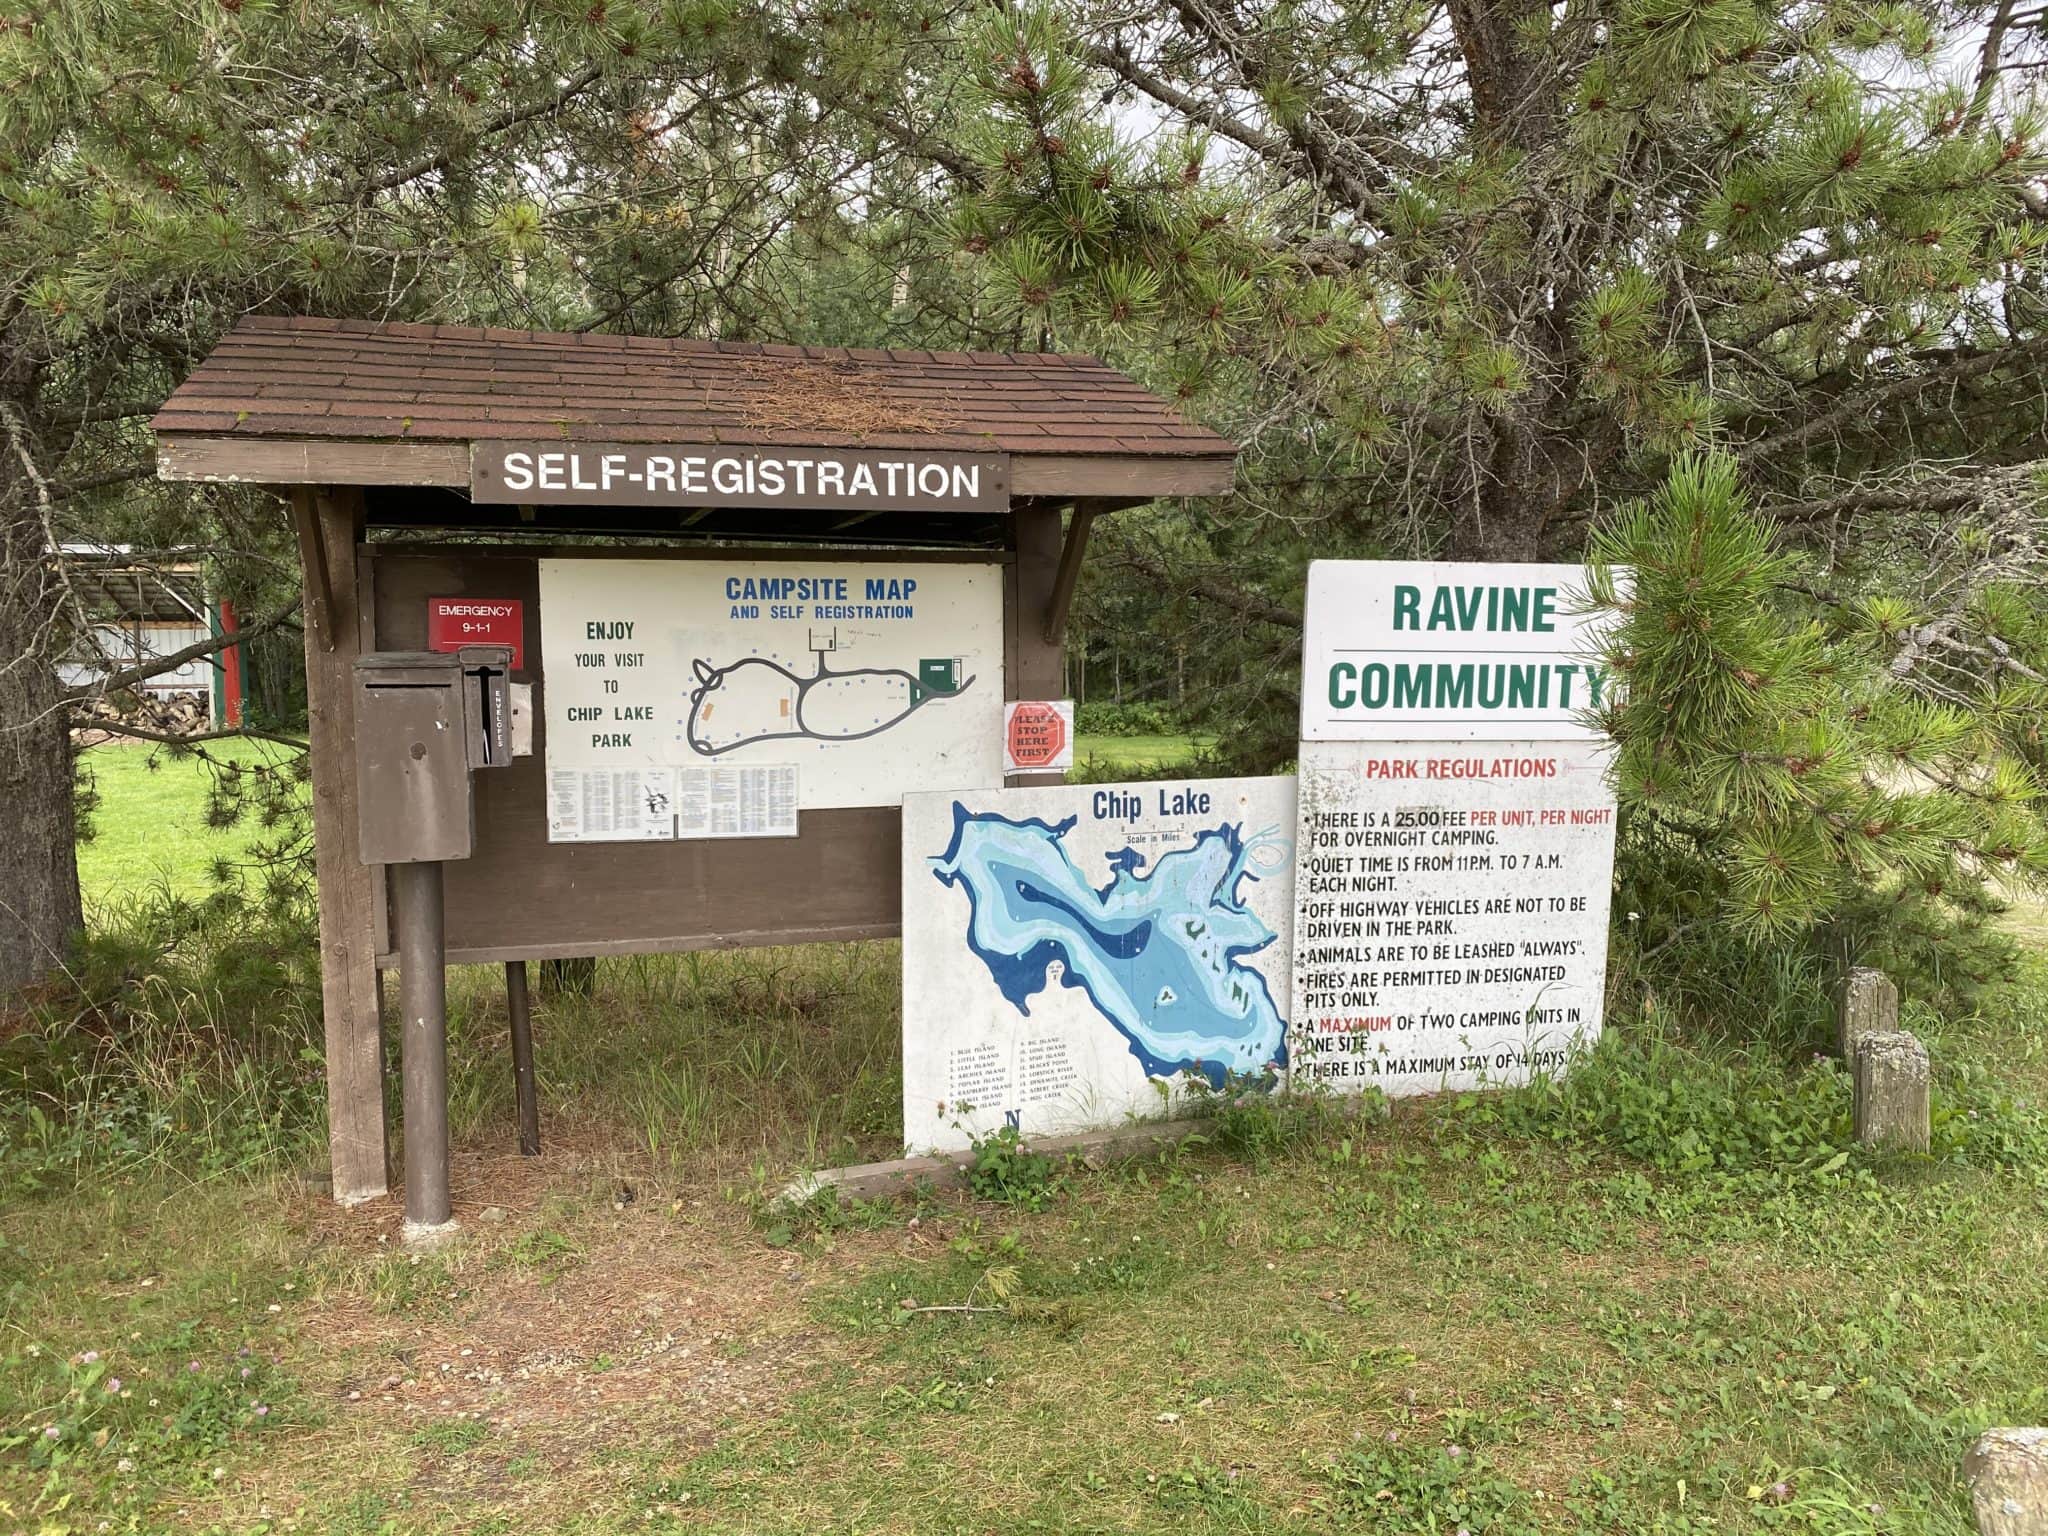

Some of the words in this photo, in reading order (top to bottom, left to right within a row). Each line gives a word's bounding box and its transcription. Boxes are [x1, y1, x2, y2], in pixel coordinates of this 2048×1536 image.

[503, 452, 979, 498] SELF-REGISTRATION
[726, 577, 848, 601] CAMPSITE
[865, 579, 917, 601] MAP
[438, 605, 513, 617] EMERGENCY
[730, 606, 759, 619] AND
[770, 606, 804, 619] SELF
[815, 606, 914, 620] REGISTRATION
[1393, 585, 1557, 632] RAVINE
[462, 622, 491, 633] 9-1-1
[586, 622, 635, 640] ENJOY
[574, 653, 606, 668] YOUR
[614, 653, 645, 668] VISIT
[603, 680, 619, 694] TO
[1328, 662, 1609, 710] COMMUNITY
[495, 690, 504, 747] ENVELOPES
[567, 707, 603, 721] CHIP
[614, 706, 654, 721] LAKE
[1017, 726, 1048, 735] STOP
[591, 734, 632, 748] PARK
[1016, 738, 1049, 746] HERE
[1016, 748, 1050, 757] FIRST
[1366, 760, 1418, 779] PARK
[1426, 758, 1556, 779] REGULATIONS
[1093, 790, 1142, 824] Chip
[1160, 788, 1210, 816] Lake
[1313, 812, 1358, 828] THERE
[1363, 812, 1376, 828] IS
[1381, 812, 1390, 828] A
[1395, 812, 1440, 828] 25.00
[1442, 812, 1466, 826] FEE
[1470, 811, 1497, 826] PER
[1502, 810, 1536, 828] UNIT,
[1540, 810, 1566, 826] PER
[1570, 809, 1612, 825] NIGHT
[1127, 834, 1146, 844] Scale
[1162, 833, 1181, 842] Miles
[1311, 832, 1339, 848] FOR
[1344, 831, 1427, 847] OVERNIGHT
[1432, 830, 1499, 846] CAMPING.
[1310, 857, 1354, 876] QUIET
[1360, 857, 1393, 872] TIME
[1398, 856, 1409, 872] IS
[1414, 856, 1453, 872] FROM
[1500, 855, 1517, 870] TO
[1522, 854, 1530, 870] 7
[1534, 854, 1563, 870] A.M.
[1310, 877, 1347, 893] EACH
[1352, 876, 1398, 892] NIGHT.
[1309, 902, 1335, 918] OFF
[1340, 901, 1409, 918] HIGHWAY
[1415, 900, 1480, 916] VEHICLES
[1484, 898, 1512, 914] ARE
[1516, 898, 1544, 913] NOT
[1548, 897, 1566, 912] TO
[1570, 896, 1587, 912] BE
[1308, 922, 1361, 938] DRIVEN
[1366, 922, 1380, 937] IN
[1385, 921, 1413, 936] THE
[1416, 920, 1457, 936] PARK.
[1308, 946, 1372, 963] ANIMALS
[1376, 946, 1405, 962] ARE
[1410, 946, 1428, 960] TO
[1432, 944, 1450, 960] BE
[1454, 942, 1515, 960] LEASHED
[1306, 973, 1345, 988] FIRES
[1350, 972, 1379, 988] ARE
[1384, 970, 1462, 987] PERMITTED
[1466, 969, 1480, 984] IN
[1484, 966, 1566, 984] DESIGNATED
[1305, 992, 1336, 1008] PITS
[1342, 992, 1380, 1008] ONLY.
[1306, 1018, 1315, 1034] A
[1319, 1016, 1392, 1034] MAXIMUM
[1397, 1016, 1415, 1031] OF
[1420, 1014, 1456, 1030] TWO
[1460, 1010, 1520, 1028] CAMPING
[1526, 1008, 1564, 1025] UNITS
[1567, 1007, 1580, 1023] IN
[1306, 1061, 1349, 1078] THERE
[1354, 1060, 1366, 1076] IS
[1386, 1057, 1456, 1074] MAXIMUM
[1460, 1054, 1490, 1071] STAY
[1496, 1053, 1512, 1068] OF
[1005, 1108, 1021, 1130] N
